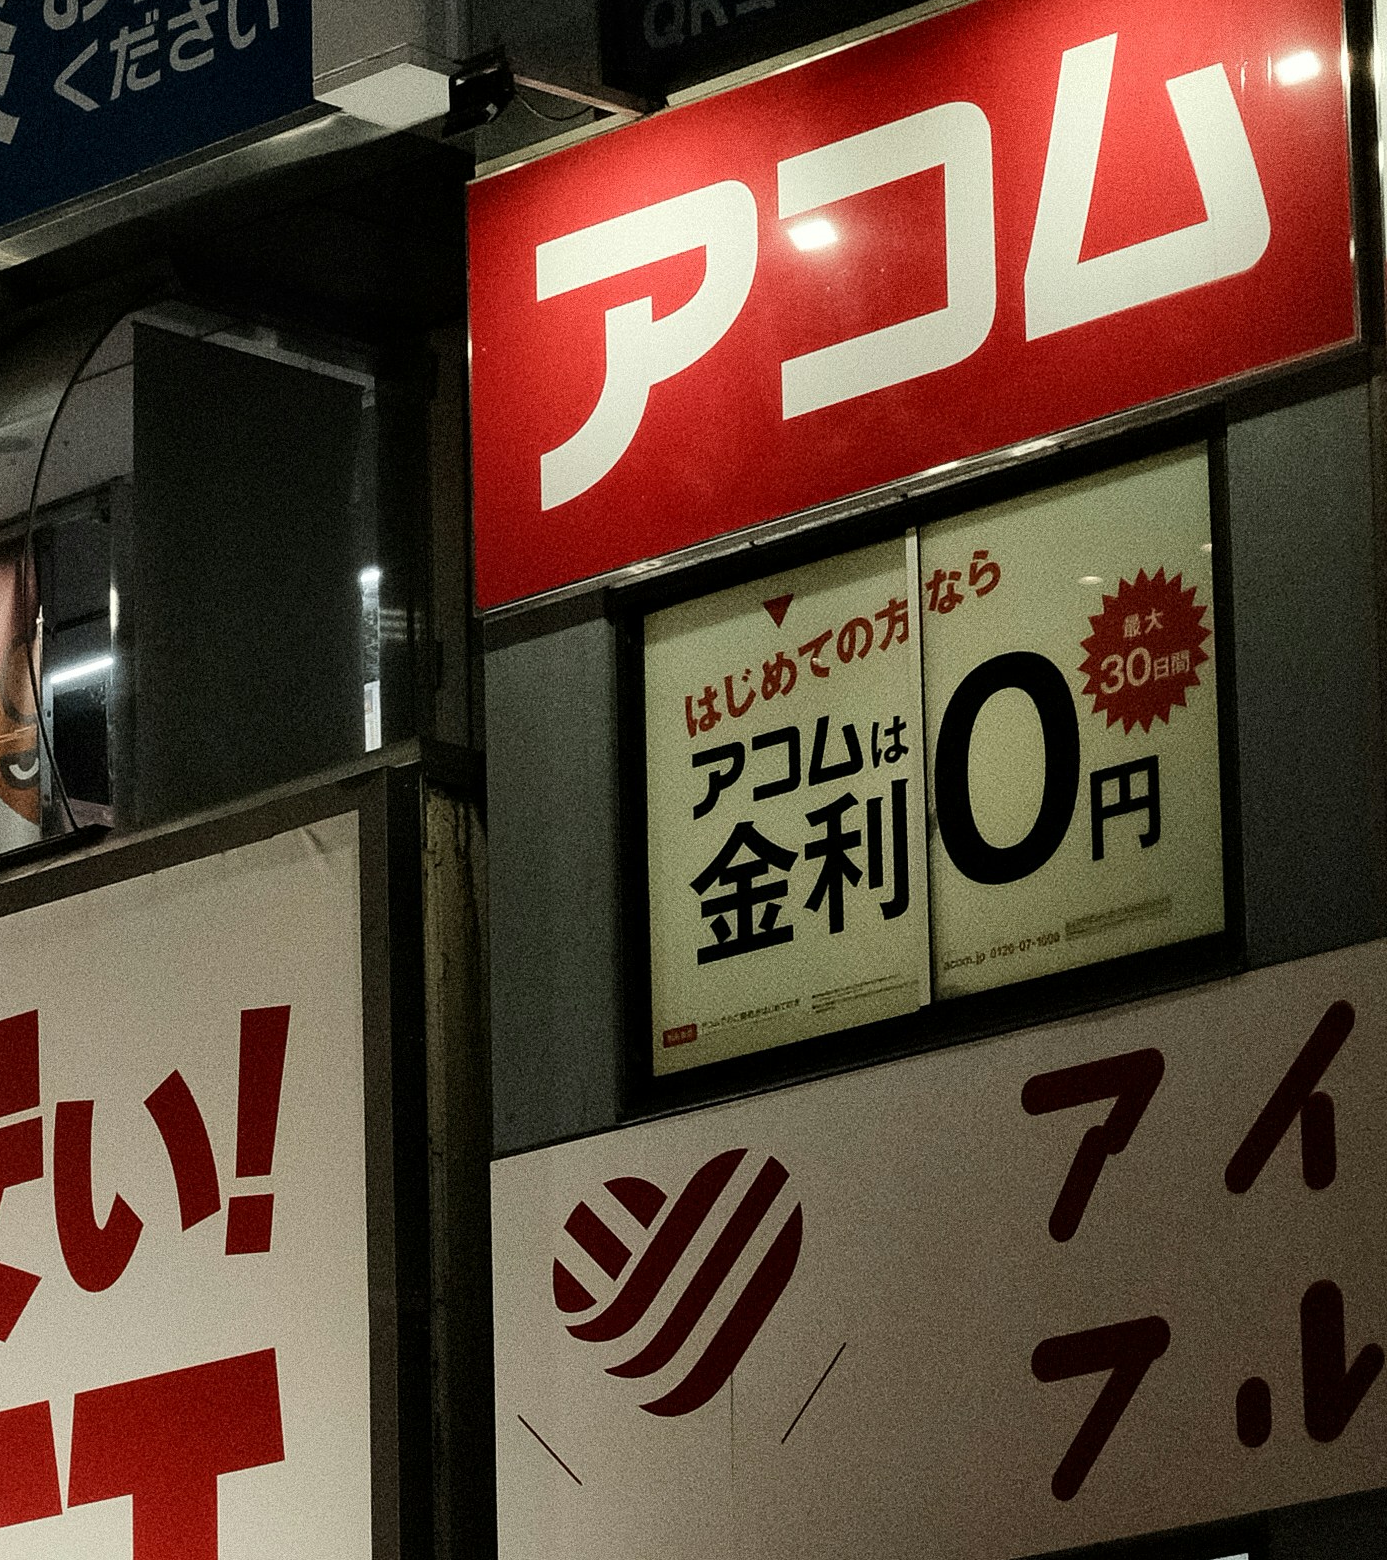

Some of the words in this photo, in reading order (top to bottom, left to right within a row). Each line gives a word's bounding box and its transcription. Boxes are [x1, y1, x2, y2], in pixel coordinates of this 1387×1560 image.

[535, 32, 1272, 512] アコム
[684, 550, 1003, 738] はじめての方なら
[1099, 646, 1191, 696] 30日間
[1122, 607, 1165, 640] 最大
[689, 778, 911, 966] 金利
[933, 651, 1162, 886] 0円
[691, 715, 910, 821] アコムは
